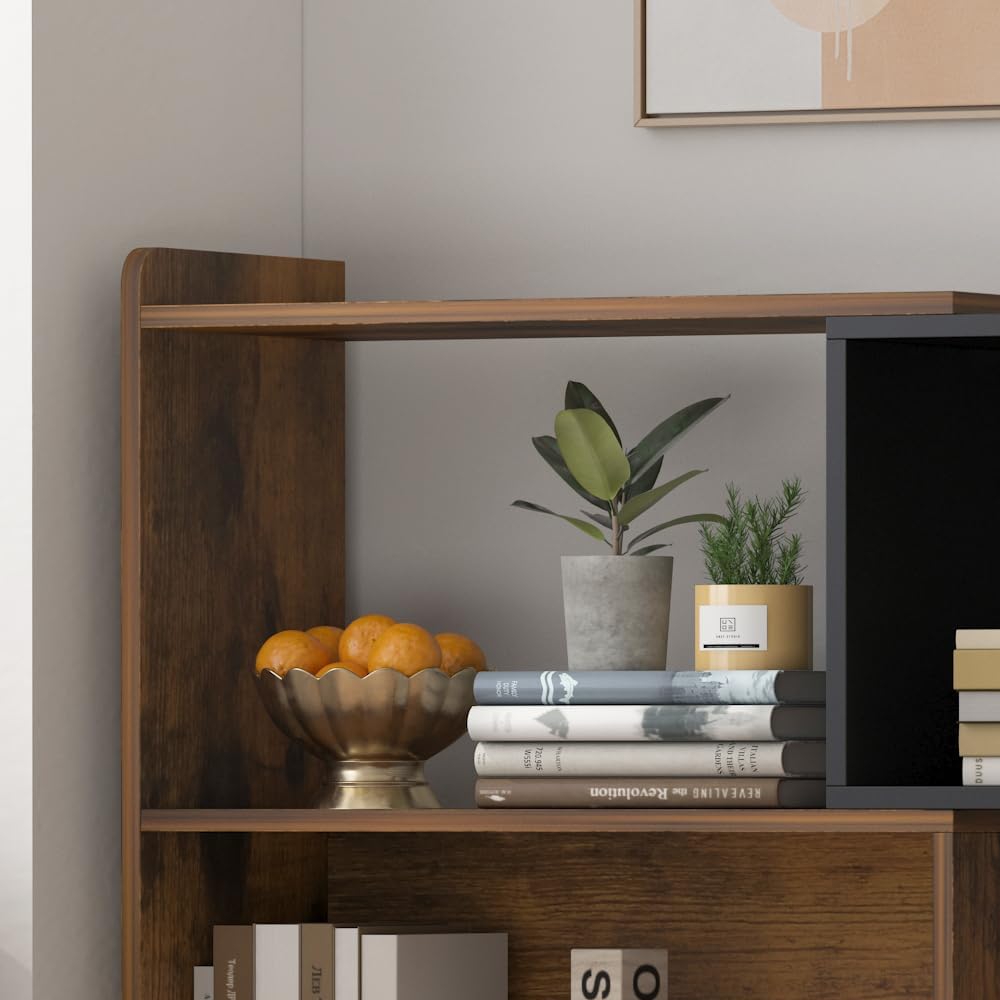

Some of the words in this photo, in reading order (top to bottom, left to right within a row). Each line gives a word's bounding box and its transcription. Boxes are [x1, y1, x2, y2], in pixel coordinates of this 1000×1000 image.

[535, 747, 544, 772] 720.945
[738, 747, 746, 772] VILLAS
[750, 745, 759, 773] ITALIAN
[975, 757, 983, 783] DUUS
[590, 786, 668, 800] Revolution
[692, 785, 761, 798] REVEALING
[582, 968, 611, 1000] S
